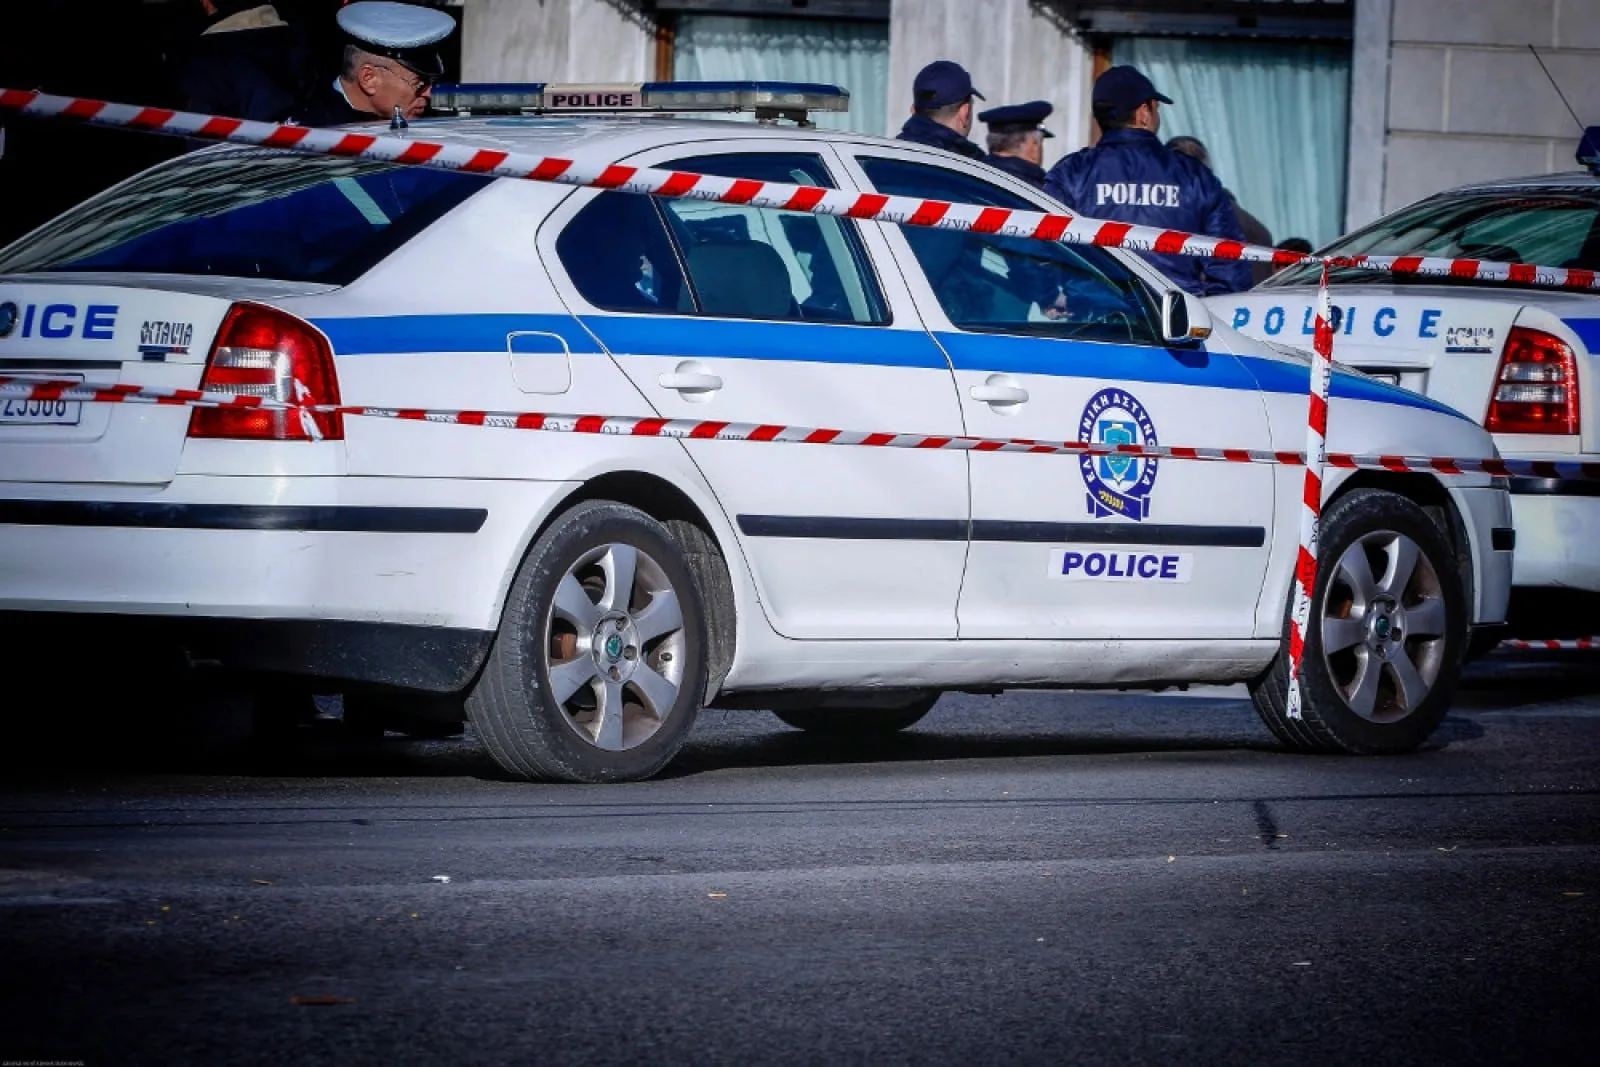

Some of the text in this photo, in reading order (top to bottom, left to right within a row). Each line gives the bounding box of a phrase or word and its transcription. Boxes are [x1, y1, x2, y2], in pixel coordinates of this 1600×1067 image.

[553, 94, 633, 107] POLICE
[1096, 183, 1180, 207] POLICE
[1062, 552, 1180, 579] POLICE
